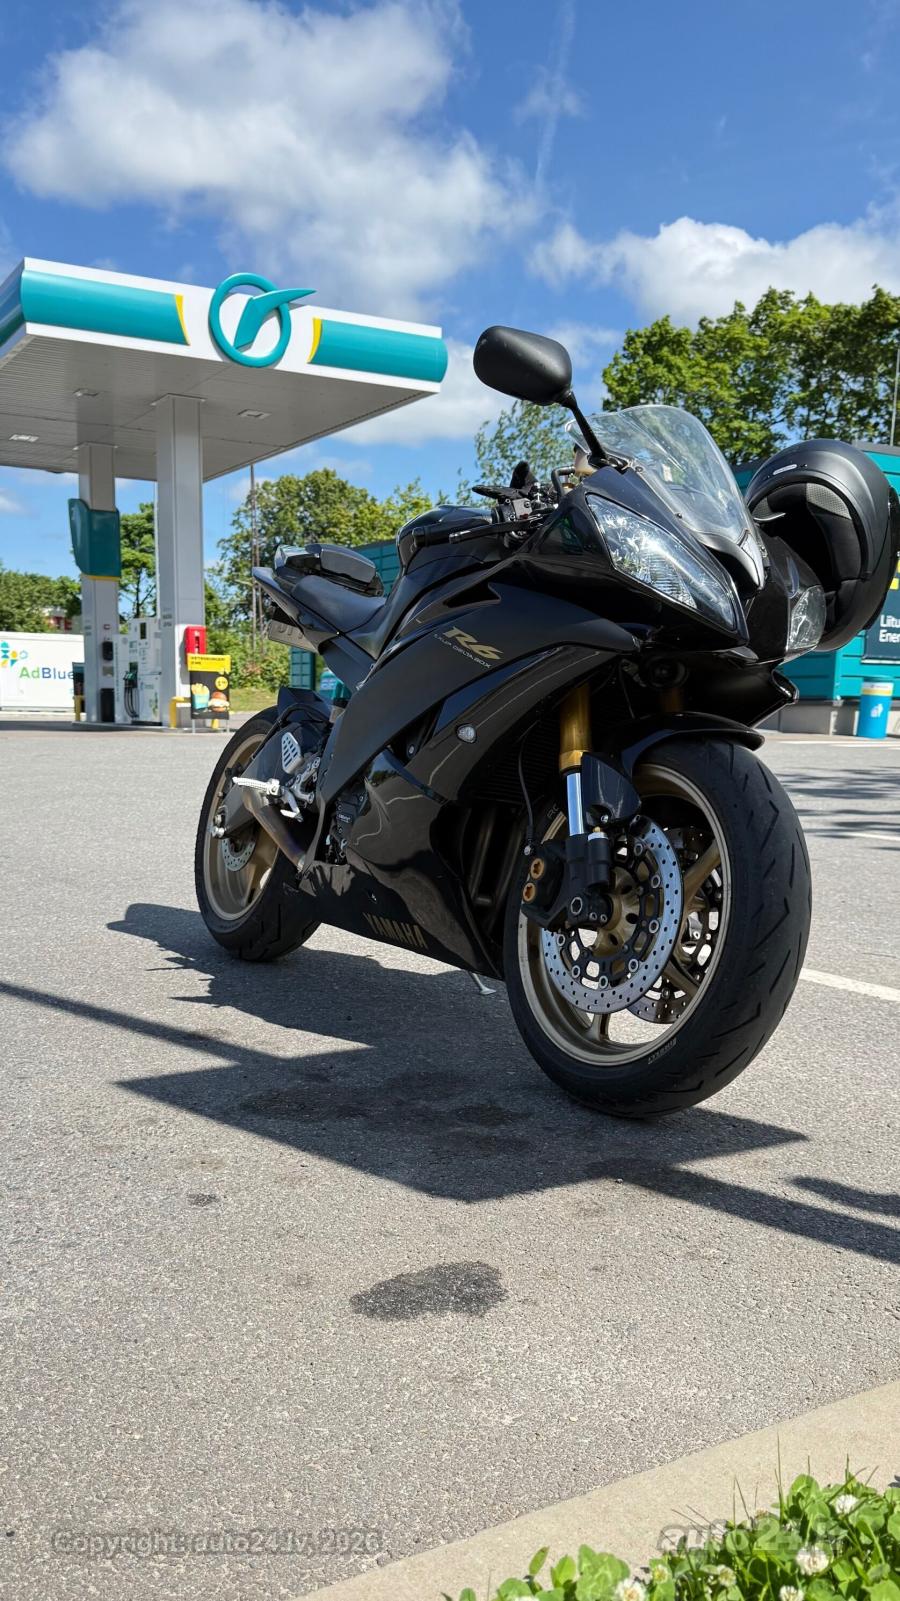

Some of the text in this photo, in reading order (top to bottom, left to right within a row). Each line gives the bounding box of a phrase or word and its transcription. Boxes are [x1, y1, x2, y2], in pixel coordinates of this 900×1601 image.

[442, 626, 504, 660] R6
[19, 666, 74, 680] AdBlue
[362, 911, 429, 951] YAMAHA
